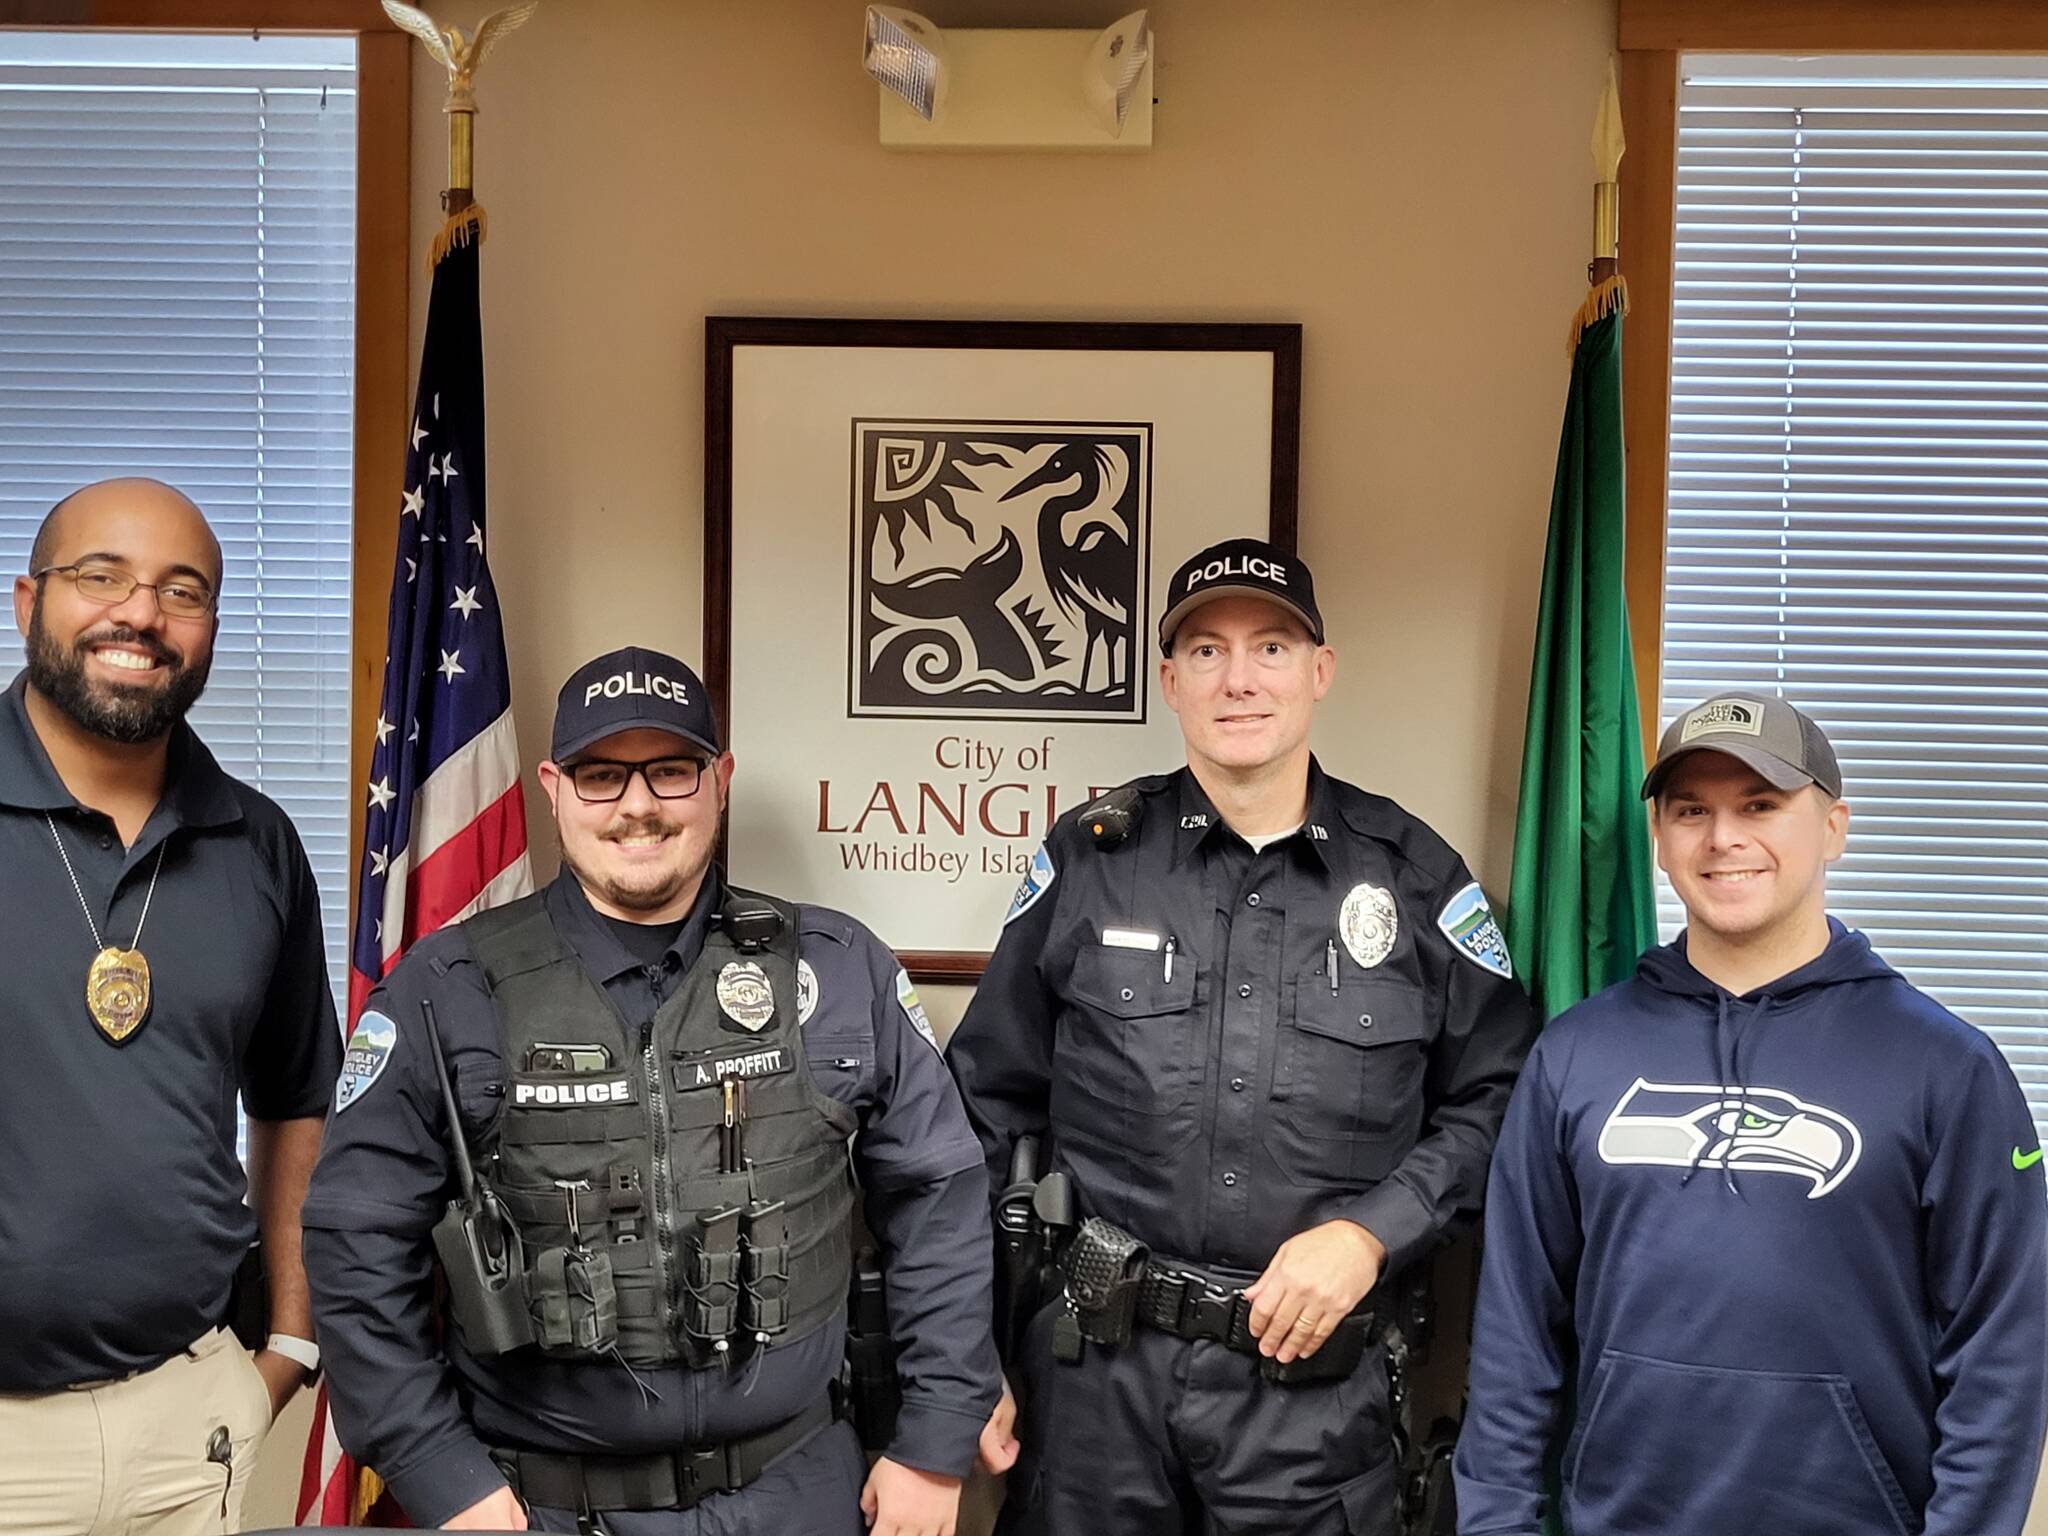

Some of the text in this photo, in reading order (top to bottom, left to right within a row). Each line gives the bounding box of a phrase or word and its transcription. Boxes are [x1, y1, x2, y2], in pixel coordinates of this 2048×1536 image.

[1186, 555, 1288, 592] POLICE
[584, 671, 689, 708] POLICE
[935, 736, 1055, 782] City of
[817, 780, 1116, 837] LANGL
[840, 842, 1035, 883] Whidbey Isla
[1465, 919, 1497, 948] LANGL
[696, 1050, 782, 1085] A. PROFFITT
[516, 1080, 630, 1104] POLICE
